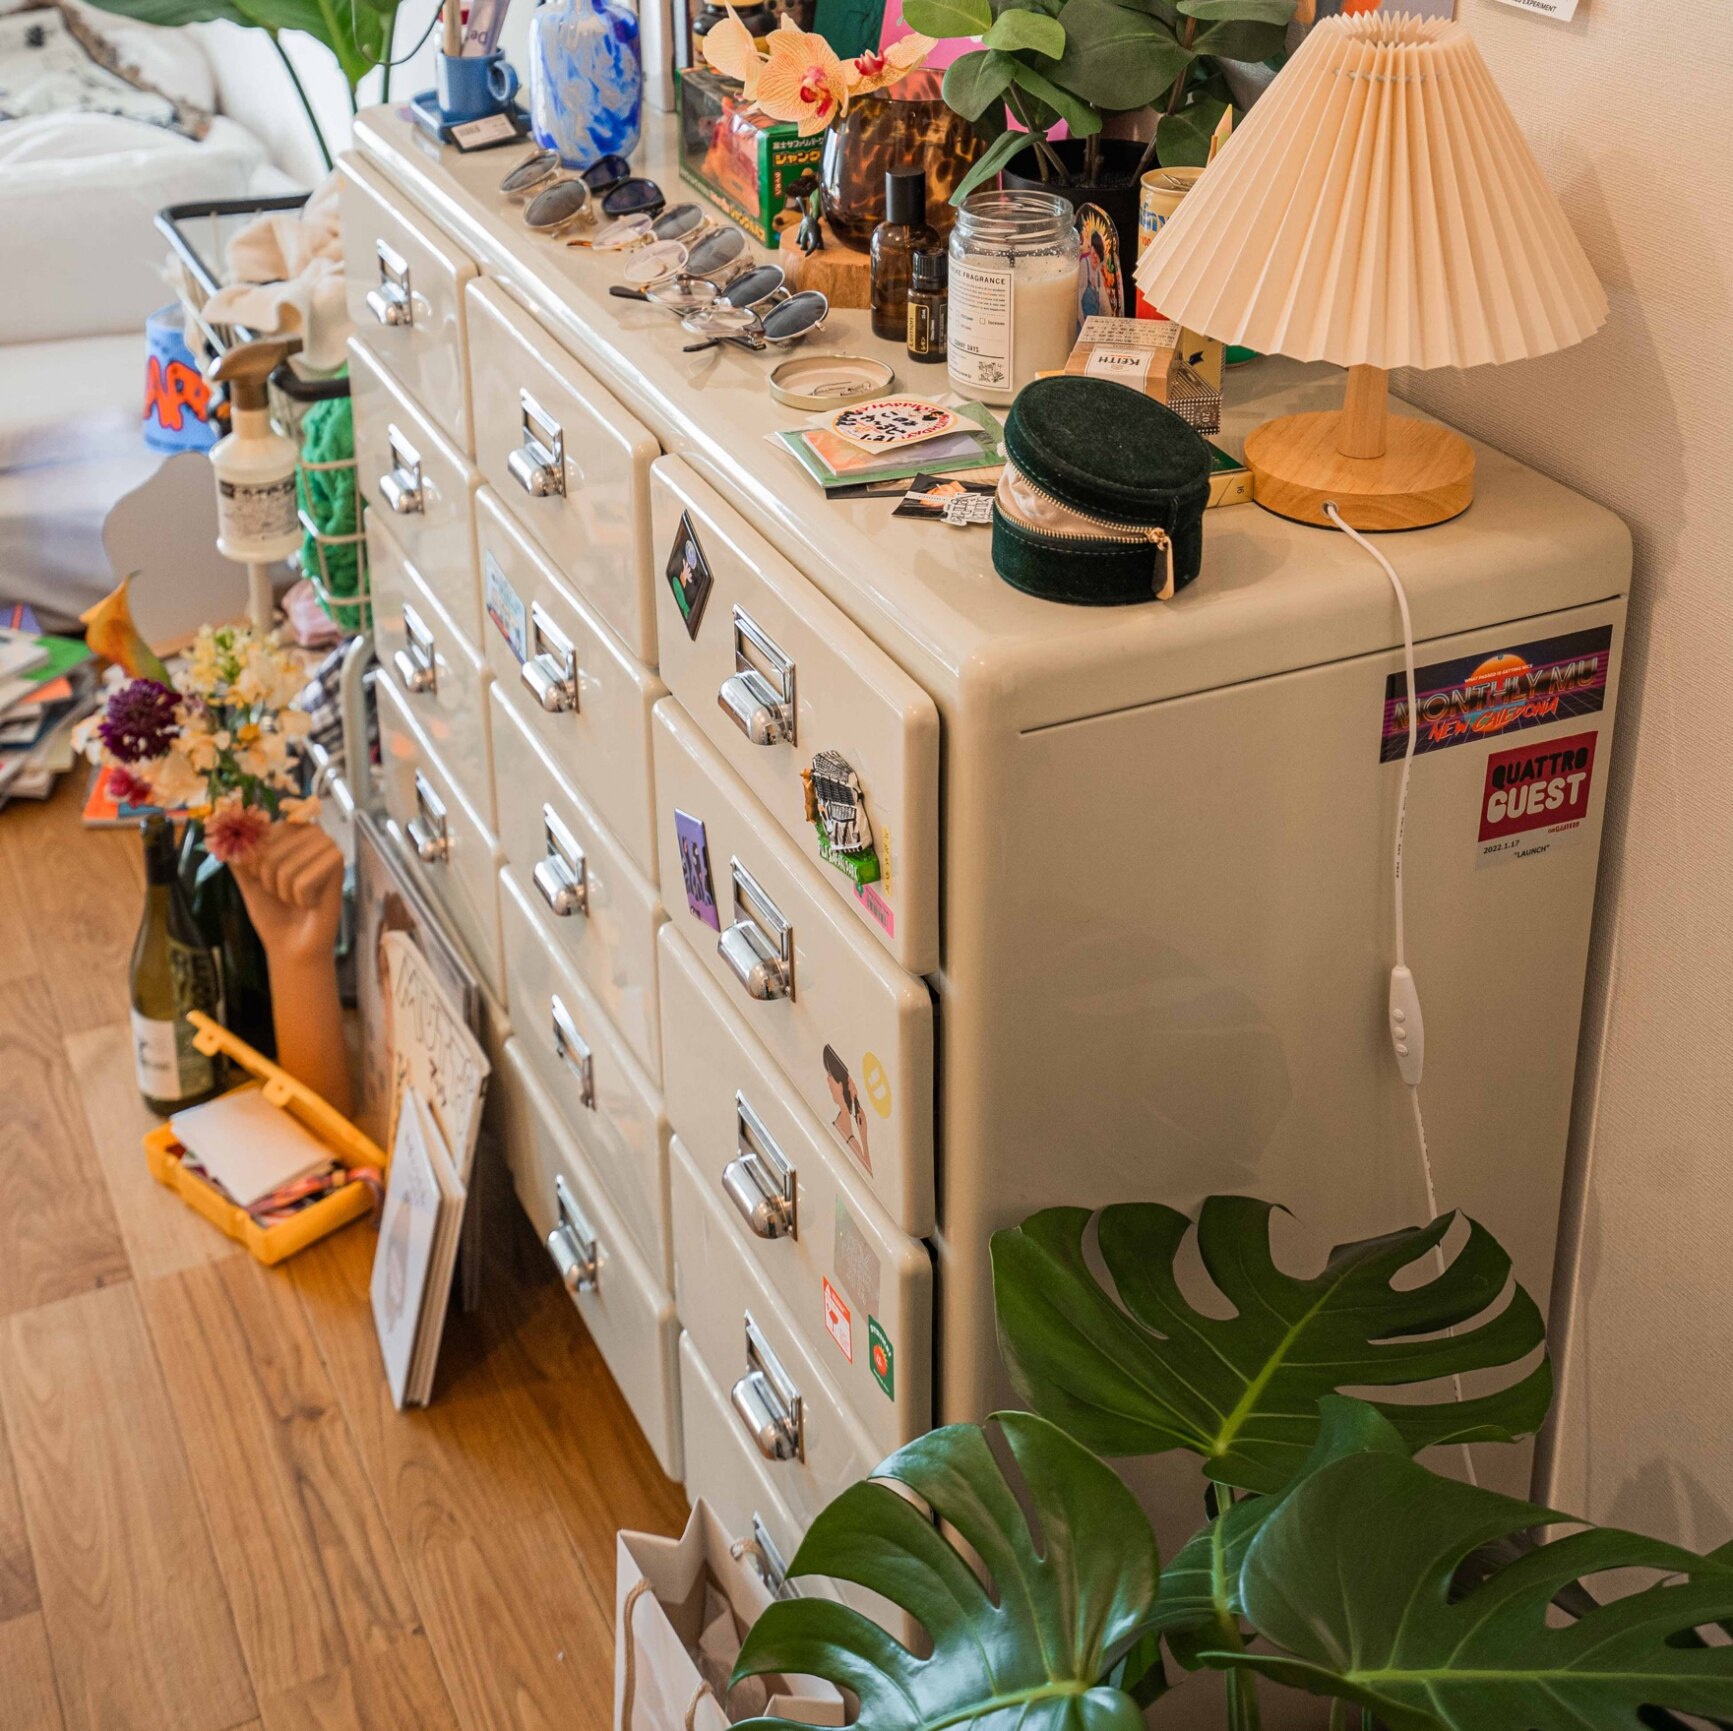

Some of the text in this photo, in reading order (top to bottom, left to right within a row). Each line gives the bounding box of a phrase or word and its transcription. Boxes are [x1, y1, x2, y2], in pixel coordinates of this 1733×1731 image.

[962, 271, 1006, 285] FRAGRANCE
[1098, 355, 1141, 367] KEITH
[1391, 656, 1600, 732] MONTHLY MU
[1427, 720, 1470, 743] NEW
[1492, 746, 1589, 790] QUATTRO
[1486, 771, 1587, 824] GUEST
[1483, 839, 1520, 855] 2022.1.17
[1514, 844, 1551, 858] "LAUNCH"
